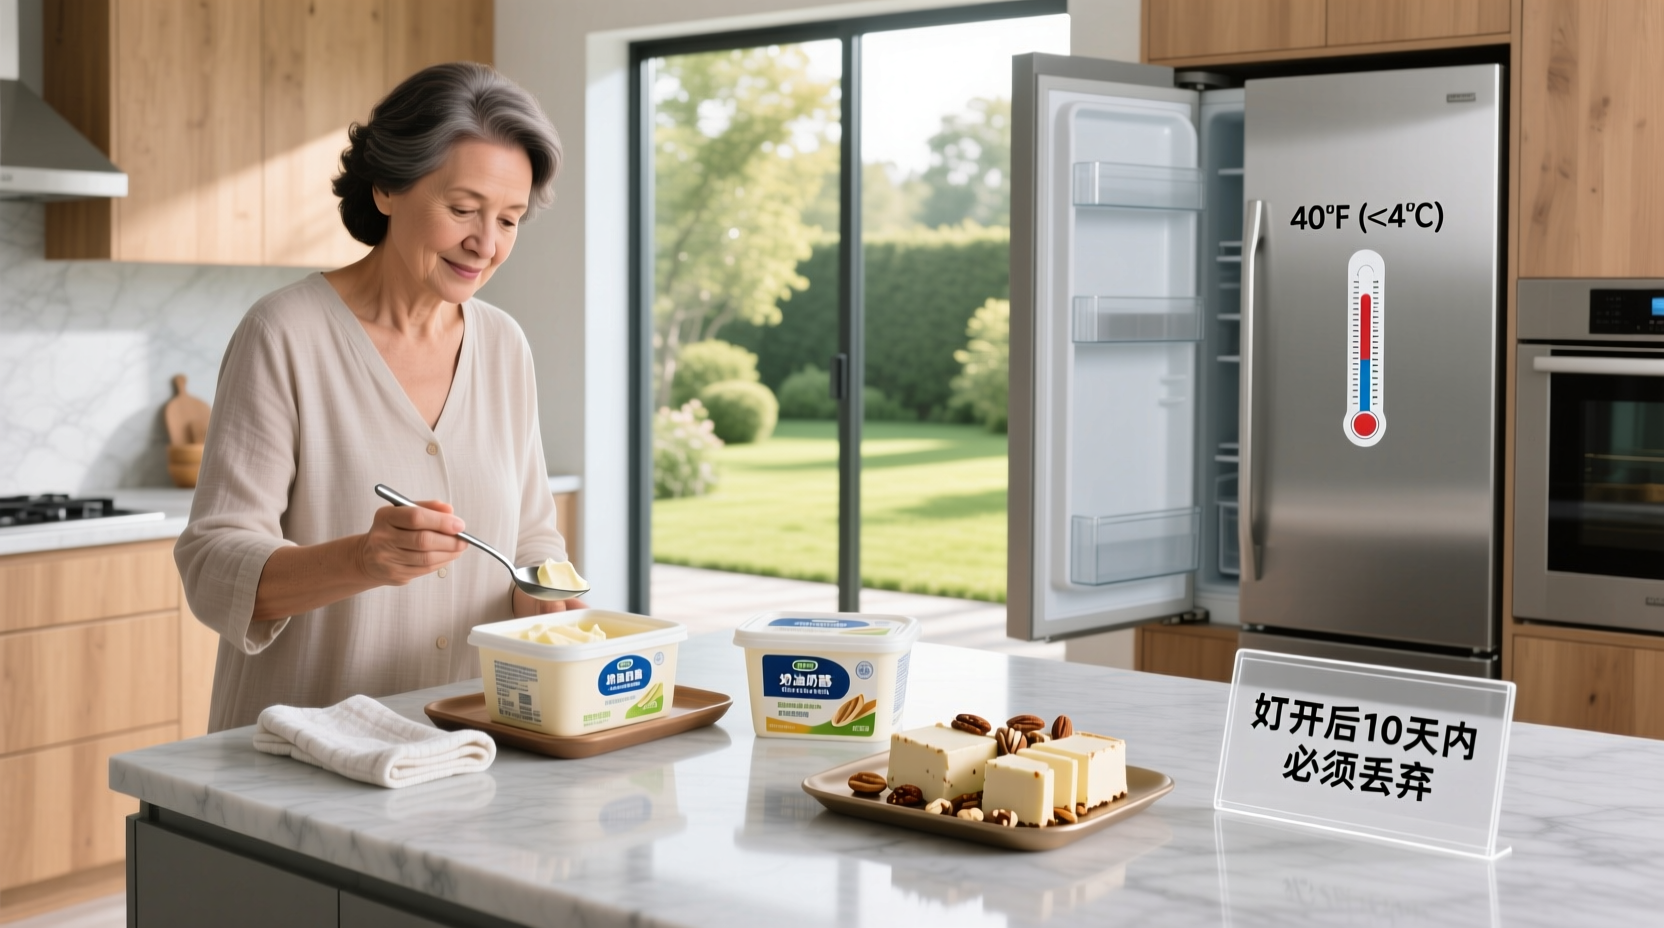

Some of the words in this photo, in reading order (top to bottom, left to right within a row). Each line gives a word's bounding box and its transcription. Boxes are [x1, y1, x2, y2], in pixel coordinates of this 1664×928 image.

[1290, 205, 1350, 230] 40°F
[1359, 201, 1444, 234] (<4°C)
[1282, 744, 1434, 802] 必须丢弃
